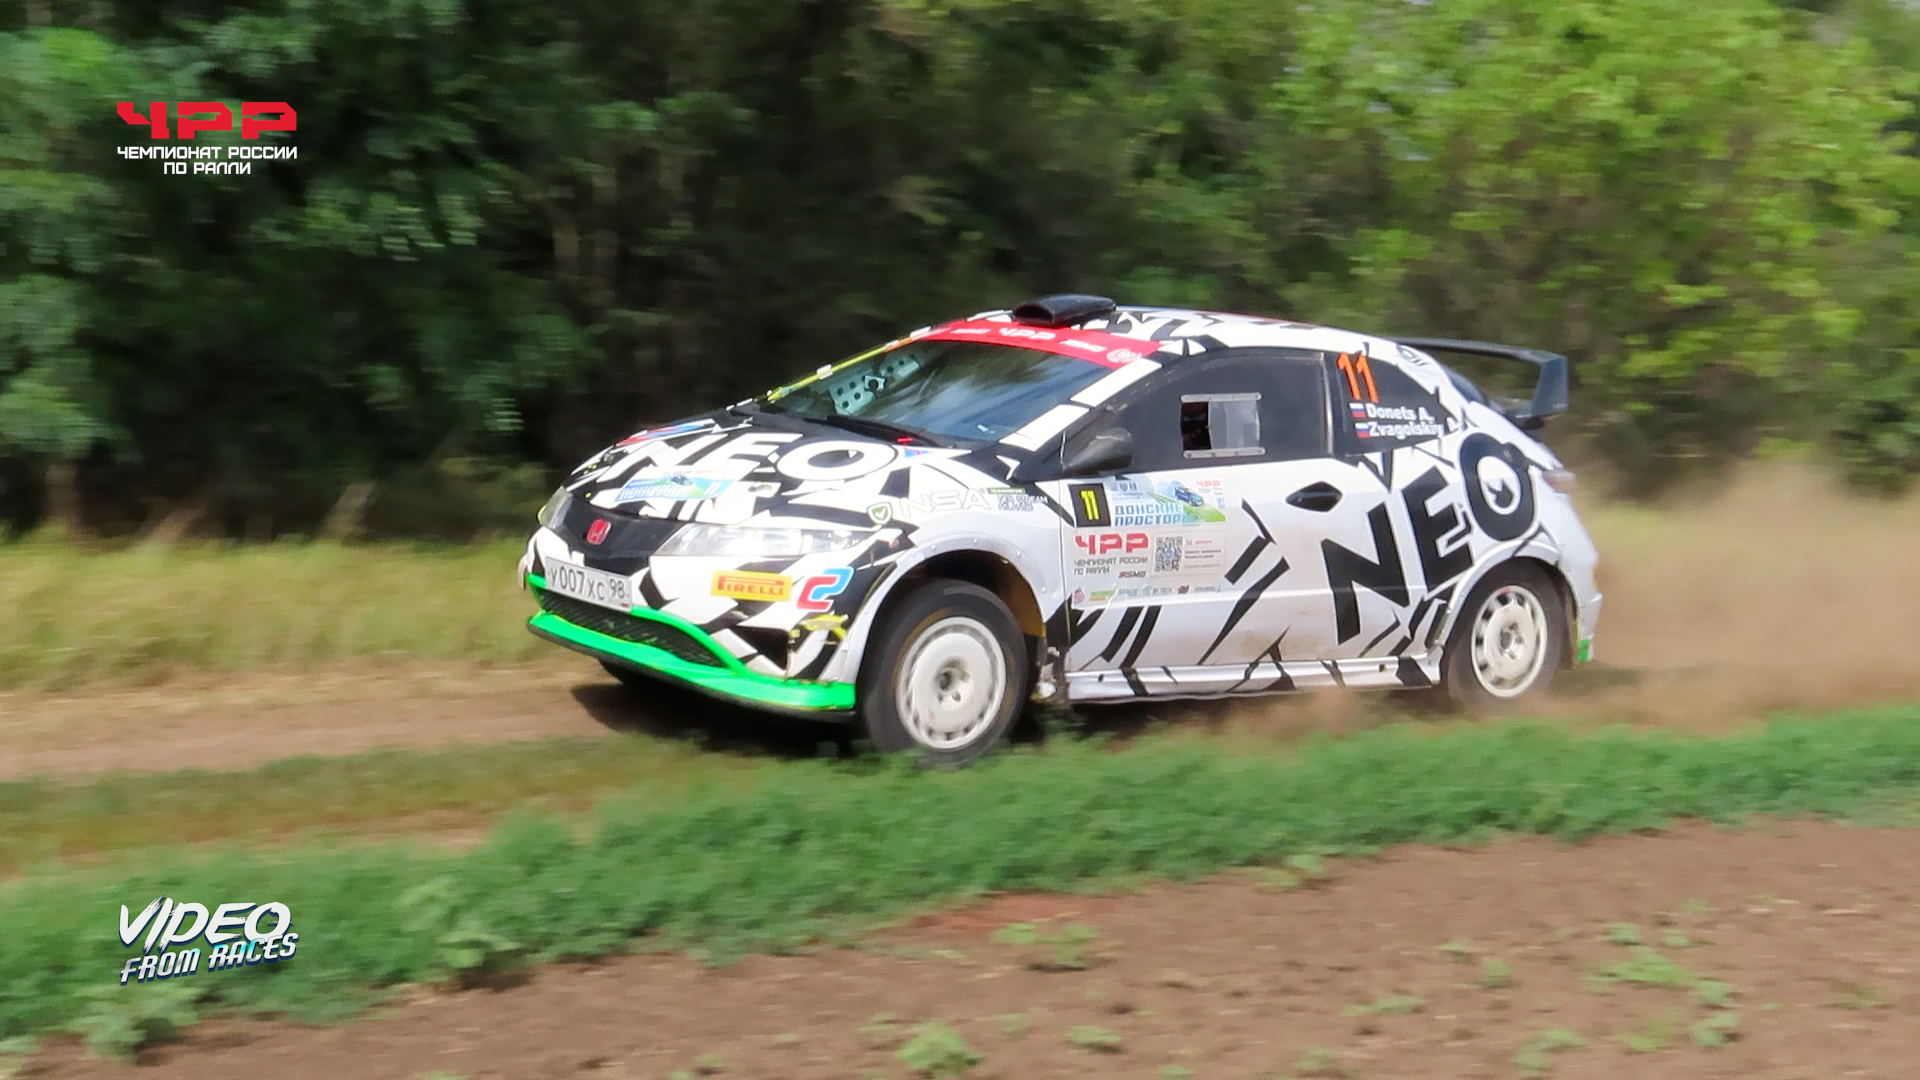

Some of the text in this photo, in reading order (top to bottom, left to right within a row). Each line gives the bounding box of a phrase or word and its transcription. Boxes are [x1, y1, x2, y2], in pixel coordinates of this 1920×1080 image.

[1336, 351, 1380, 404] 11
[1365, 403, 1418, 421] Donets
[1368, 421, 1445, 440] Zvagolskiy
[899, 488, 991, 518] NSA
[1080, 490, 1100, 521] 11
[1115, 503, 1183, 515] ДОНСКИЕ
[1114, 513, 1196, 526] ПРОСТОРЫ
[1074, 533, 1149, 555] ЧРР
[1321, 431, 1537, 645] NEO
[1074, 556, 1148, 566] ЧЕМПИОНАТ РОССИИ
[1085, 567, 1110, 576] РАЛЛИ
[608, 578, 625, 599] 98
[717, 575, 785, 596] PIRELLI
